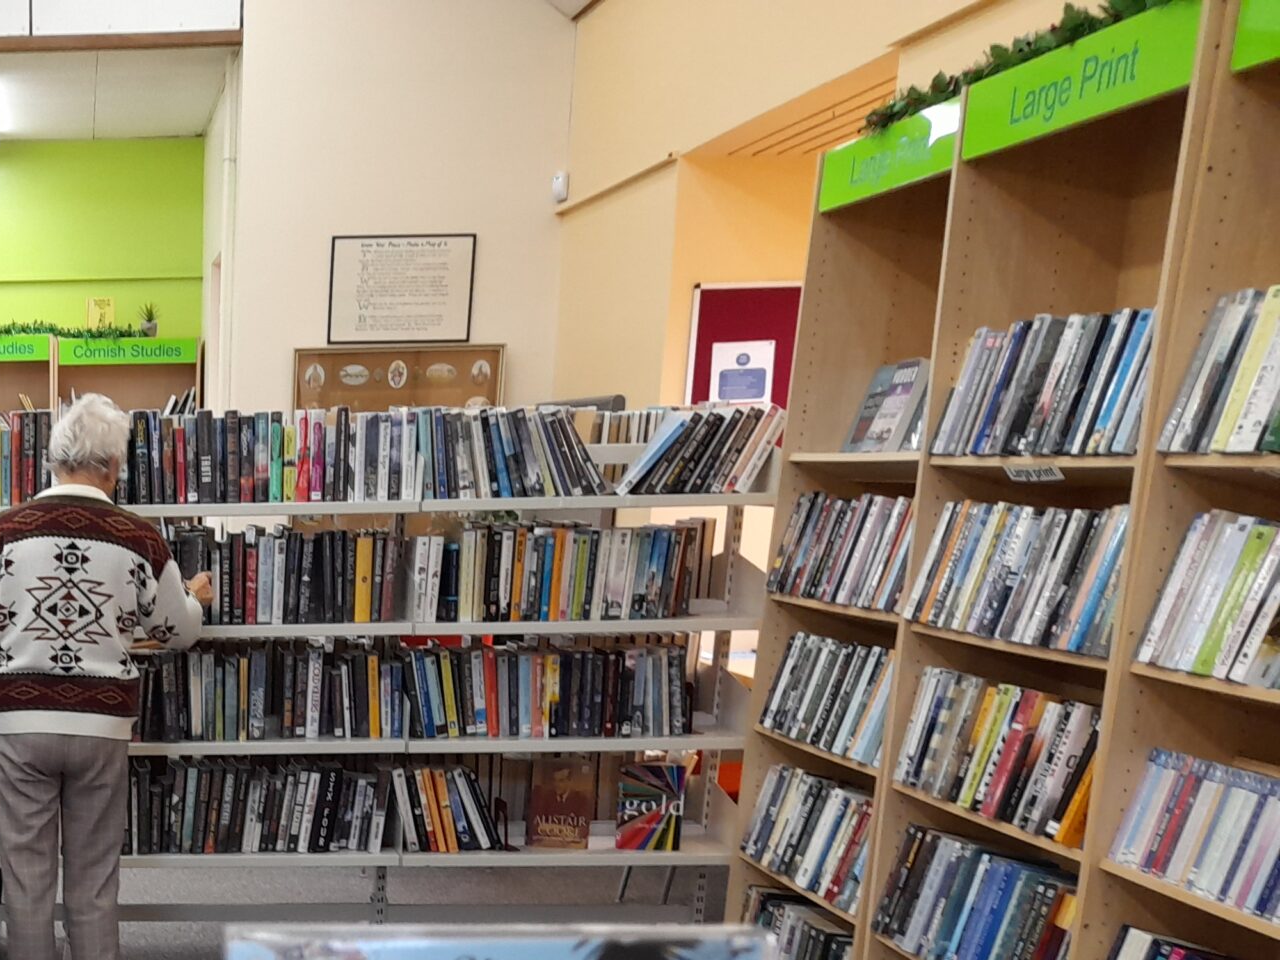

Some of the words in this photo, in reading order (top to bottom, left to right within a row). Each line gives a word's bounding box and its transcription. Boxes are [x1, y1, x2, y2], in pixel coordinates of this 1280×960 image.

[1009, 73, 1072, 125] Large
[1079, 39, 1141, 93] Print
[72, 344, 127, 359] Cornish
[130, 343, 182, 359] Studies
[325, 771, 337, 802] SIX
[534, 813, 587, 828] ALISTAIR
[624, 793, 685, 821] gold
[318, 807, 331, 848] FOUR
